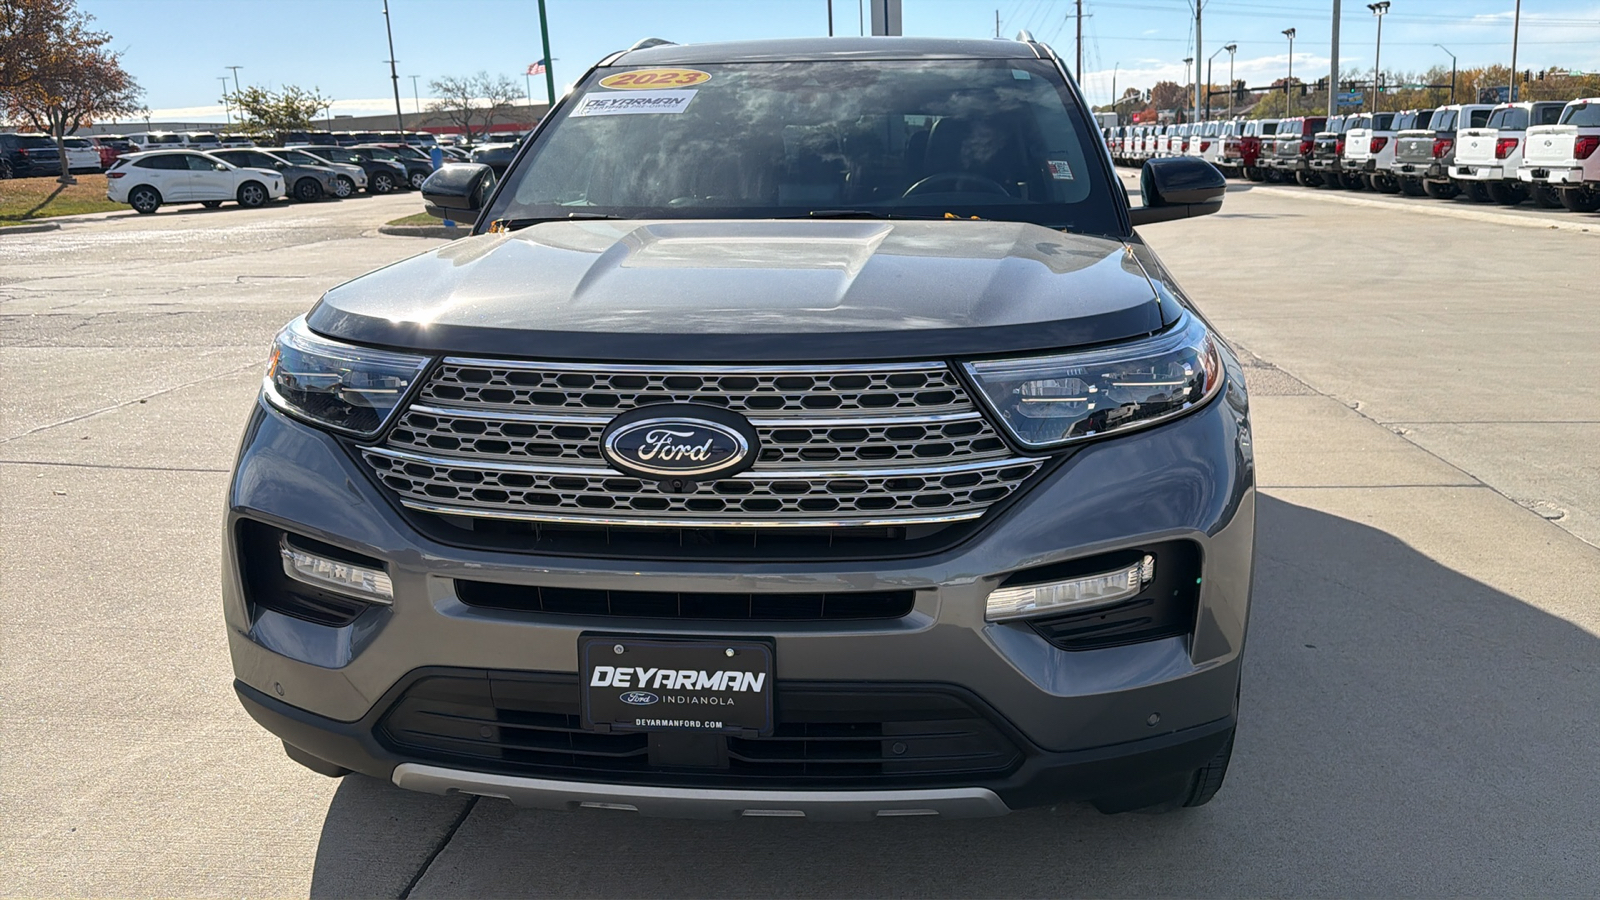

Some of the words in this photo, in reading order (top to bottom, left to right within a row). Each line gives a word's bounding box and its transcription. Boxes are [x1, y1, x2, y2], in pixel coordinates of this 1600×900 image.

[609, 73, 702, 86] 2023
[586, 97, 686, 108] DEYARMAN
[637, 429, 714, 461] Ford
[590, 666, 766, 692] DEYARMAN
[627, 692, 651, 703] Ford
[662, 695, 735, 705] INDIANOLA
[636, 718, 723, 728] DEYARMANFORD.COM
